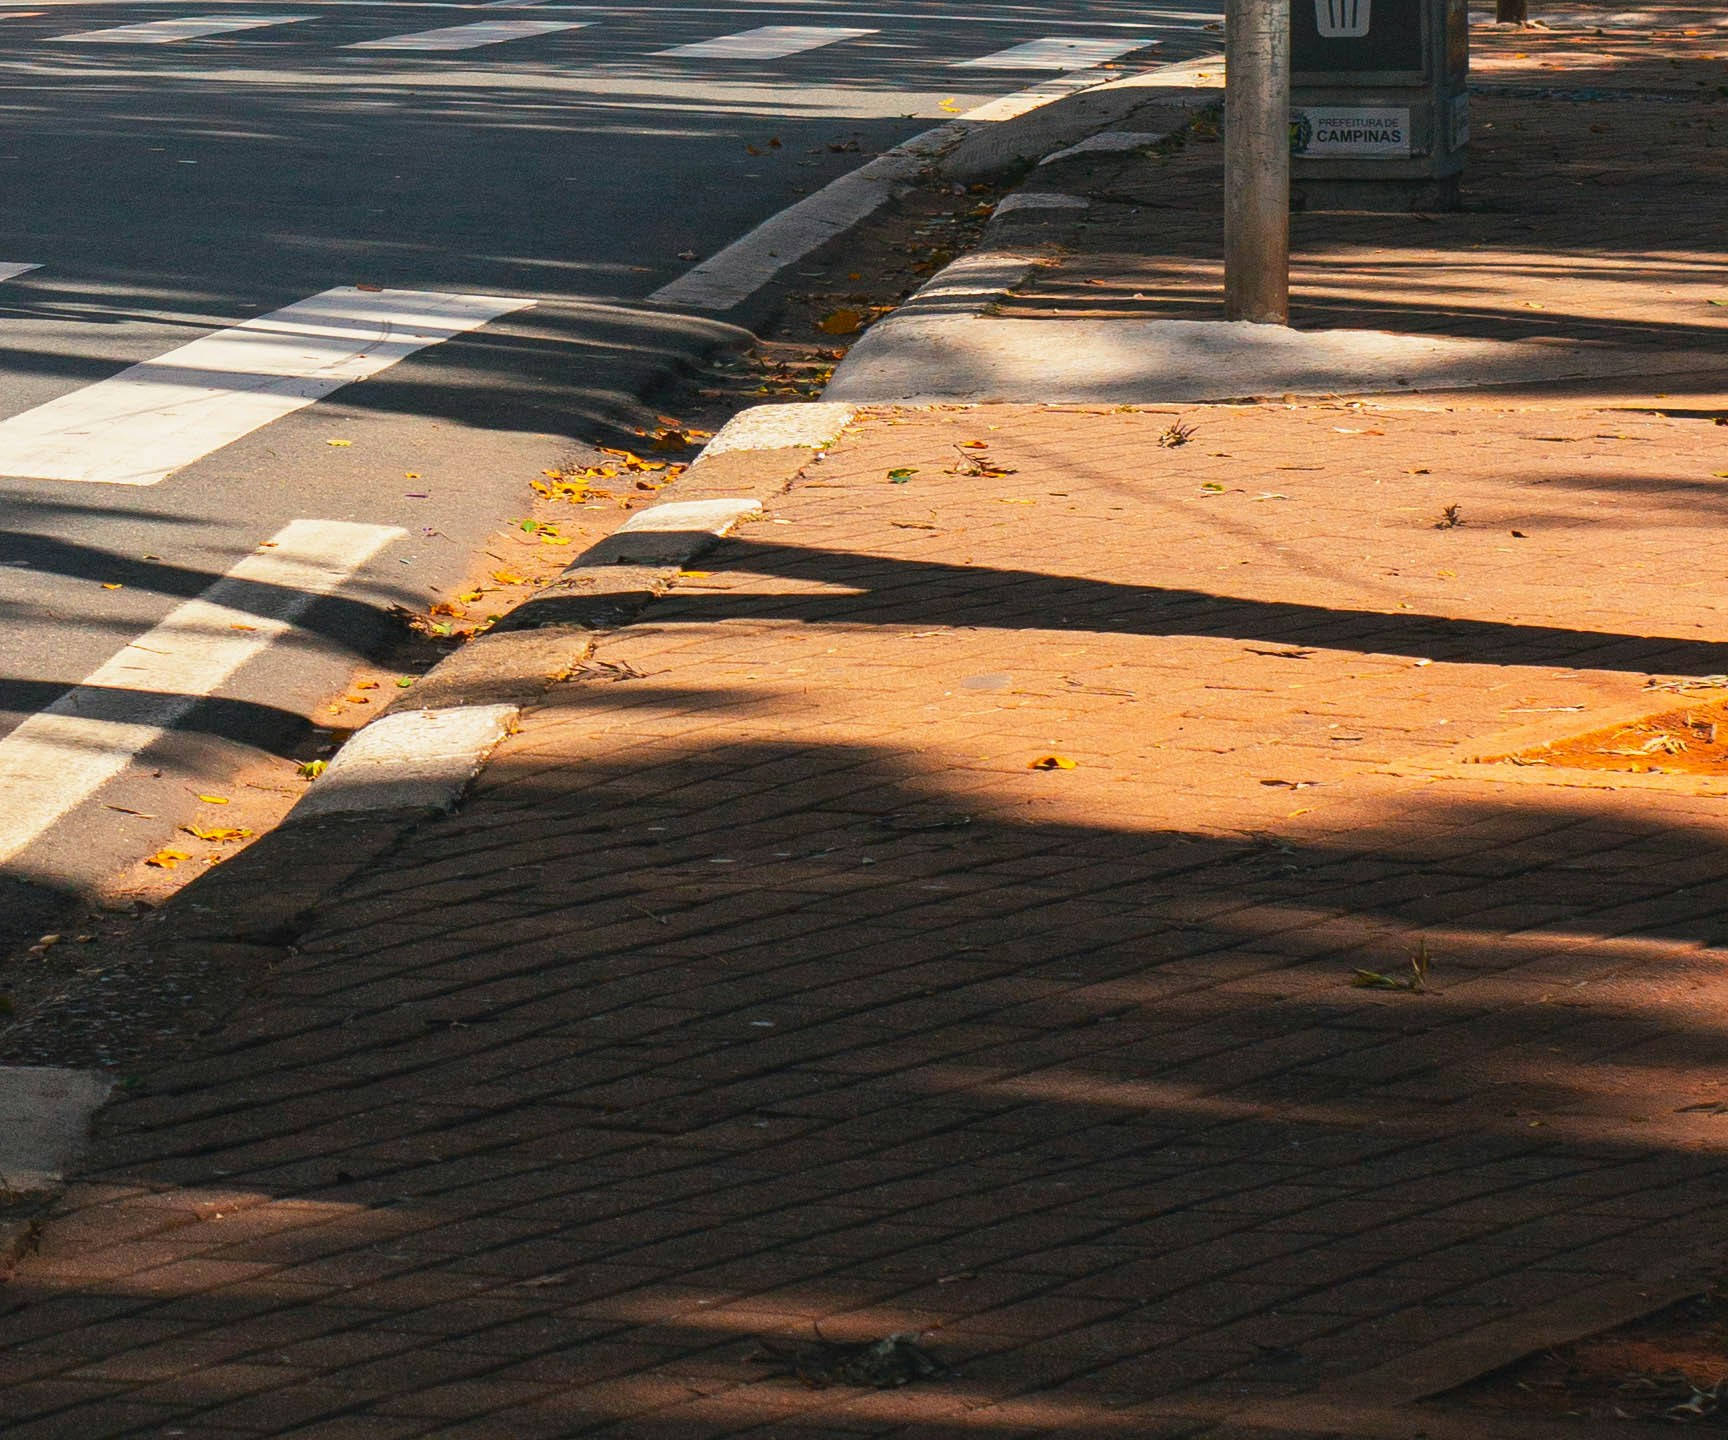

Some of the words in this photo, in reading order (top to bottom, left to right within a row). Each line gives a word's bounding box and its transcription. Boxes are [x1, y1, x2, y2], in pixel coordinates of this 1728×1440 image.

[1318, 118, 1384, 128] PREFEITURA
[1385, 118, 1399, 128] DE
[1316, 129, 1402, 143] CAMPINAS
